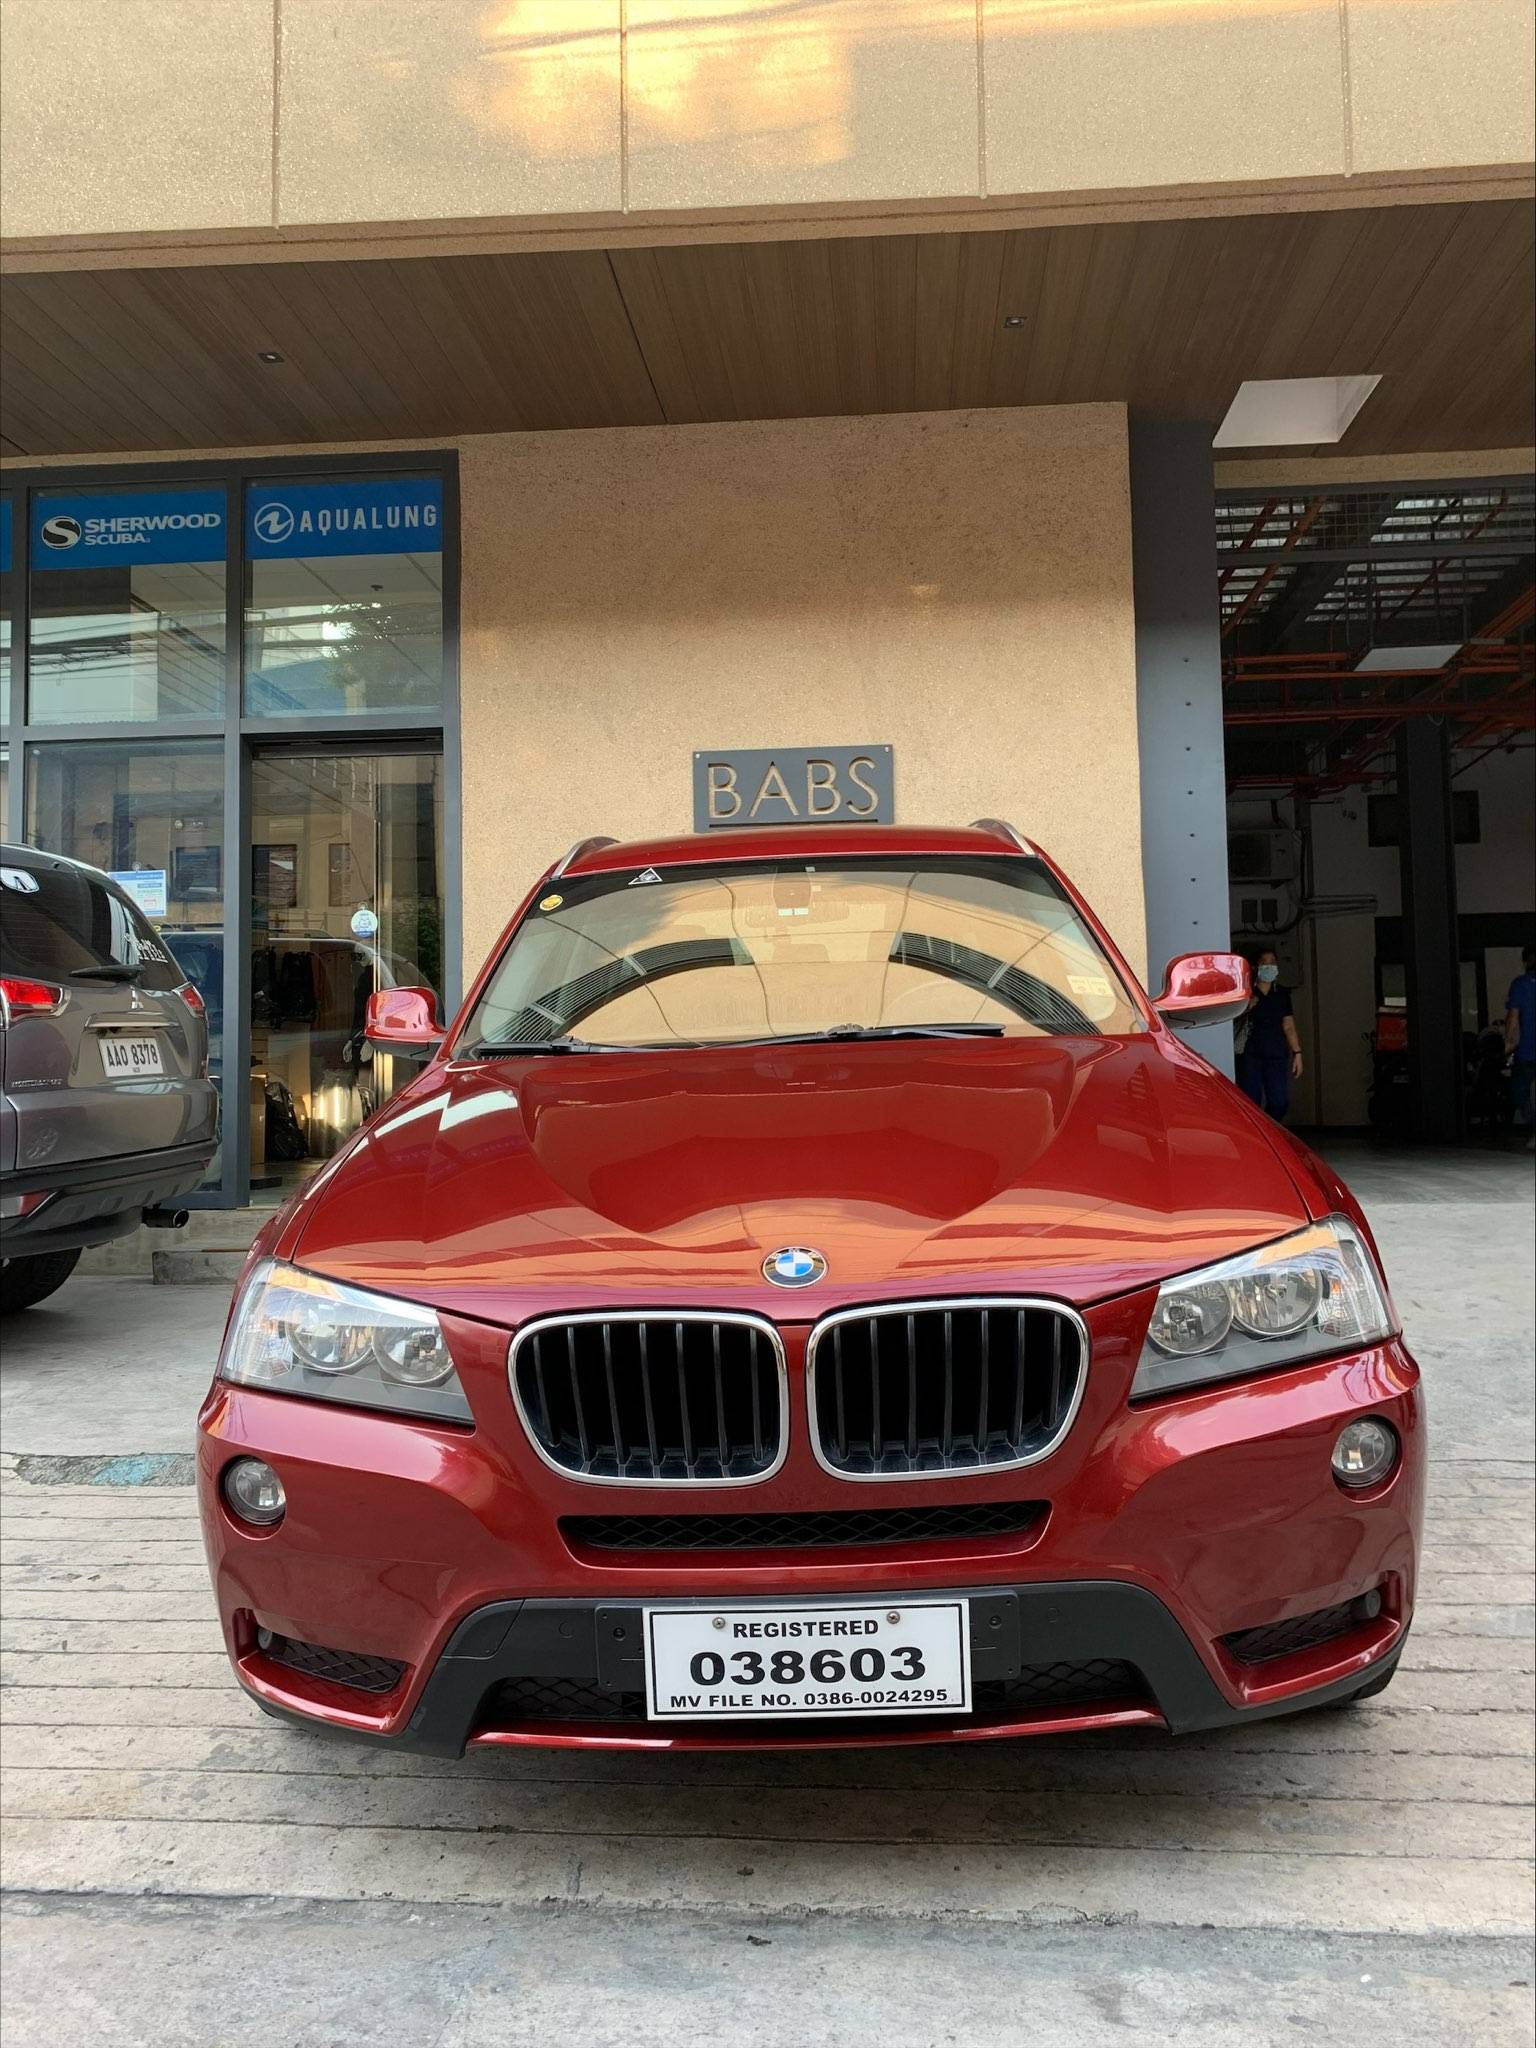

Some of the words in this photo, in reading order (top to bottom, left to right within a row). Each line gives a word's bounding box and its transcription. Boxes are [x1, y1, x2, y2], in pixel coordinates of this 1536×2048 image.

[84, 513, 221, 534] SHERWOOD
[299, 504, 437, 536] AQUALUNG
[84, 532, 147, 546] SCUBA
[707, 756, 879, 819] BABS
[131, 1043, 159, 1065] 8378
[733, 1619, 879, 1638] REGISTERED
[690, 1646, 926, 1686] 038603
[670, 1695, 702, 1708] MV
[709, 1693, 753, 1707] FILE
[761, 1692, 797, 1707] NO.
[804, 1688, 948, 1706] 0386-0024295
